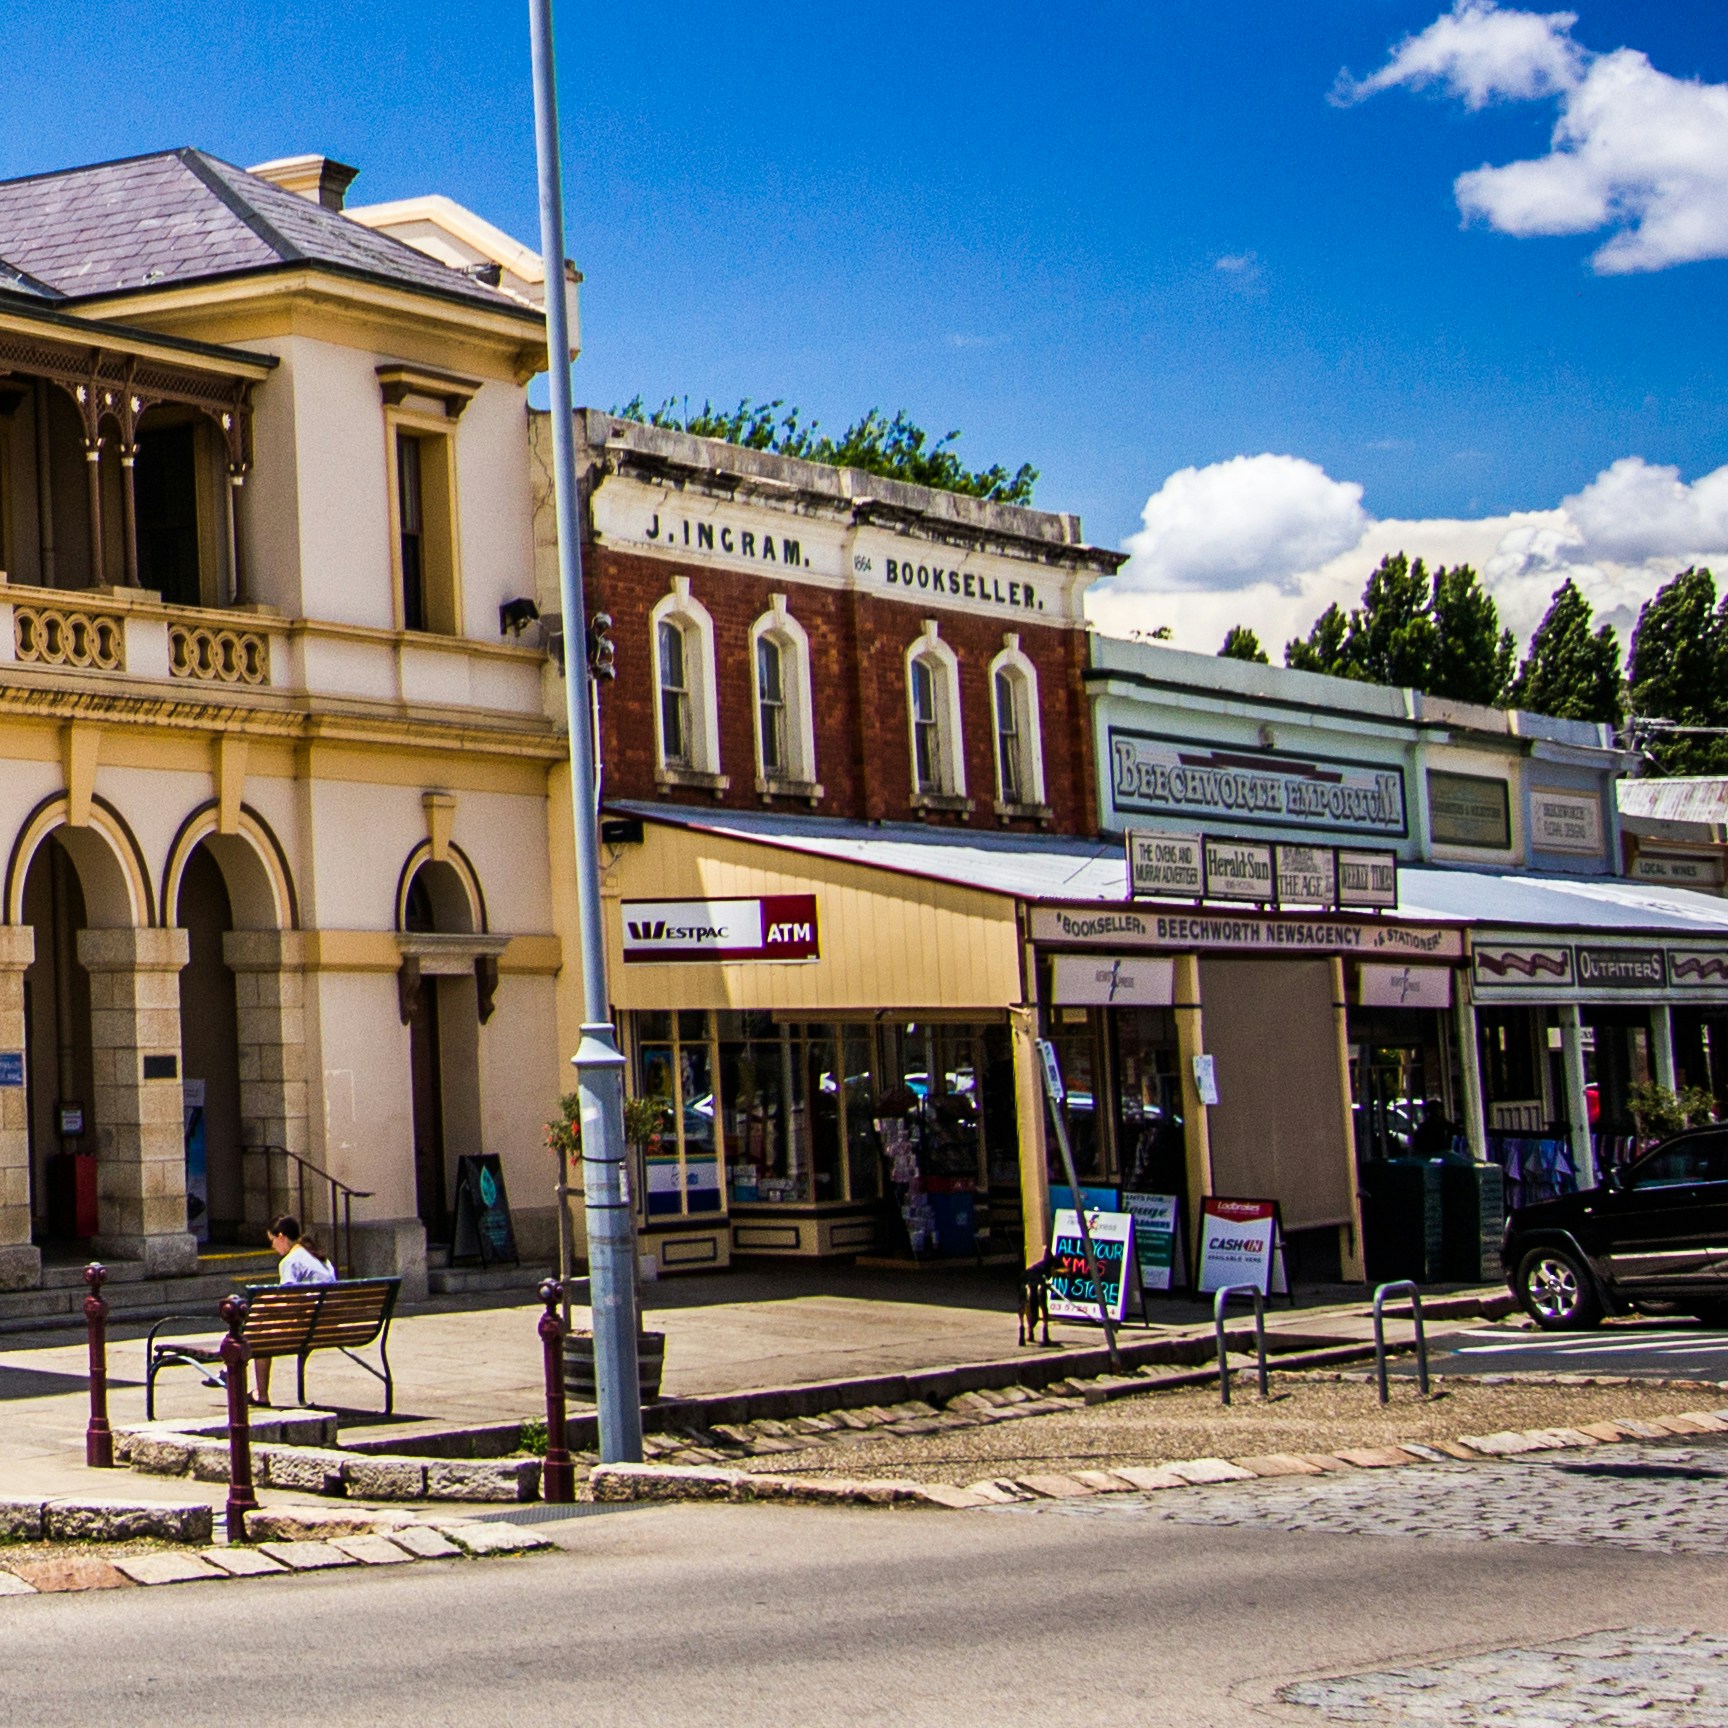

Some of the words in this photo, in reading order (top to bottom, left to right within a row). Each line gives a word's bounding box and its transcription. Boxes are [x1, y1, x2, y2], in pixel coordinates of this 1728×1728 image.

[886, 558, 1044, 611] BOOKSELLER.
[1116, 741, 1282, 813] BEECHWORTH
[1286, 775, 1400, 827] EMPORIUM
[1138, 843, 1153, 862] THE
[1179, 846, 1193, 864] AND
[1639, 862, 1666, 875] LOCAL
[1671, 864, 1697, 877] WINES
[1279, 875, 1300, 896] THE
[1301, 876, 1323, 898] AGE
[767, 923, 811, 943] ATM
[1157, 918, 1261, 942] BEECHWORTH
[1265, 923, 1361, 946] NEWSAGENCY
[1217, 1201, 1261, 1212] Ladbrokes
[1058, 1238, 1087, 1256] ALL
[1091, 1240, 1124, 1260] YOUR
[1209, 1237, 1244, 1251] CASH
